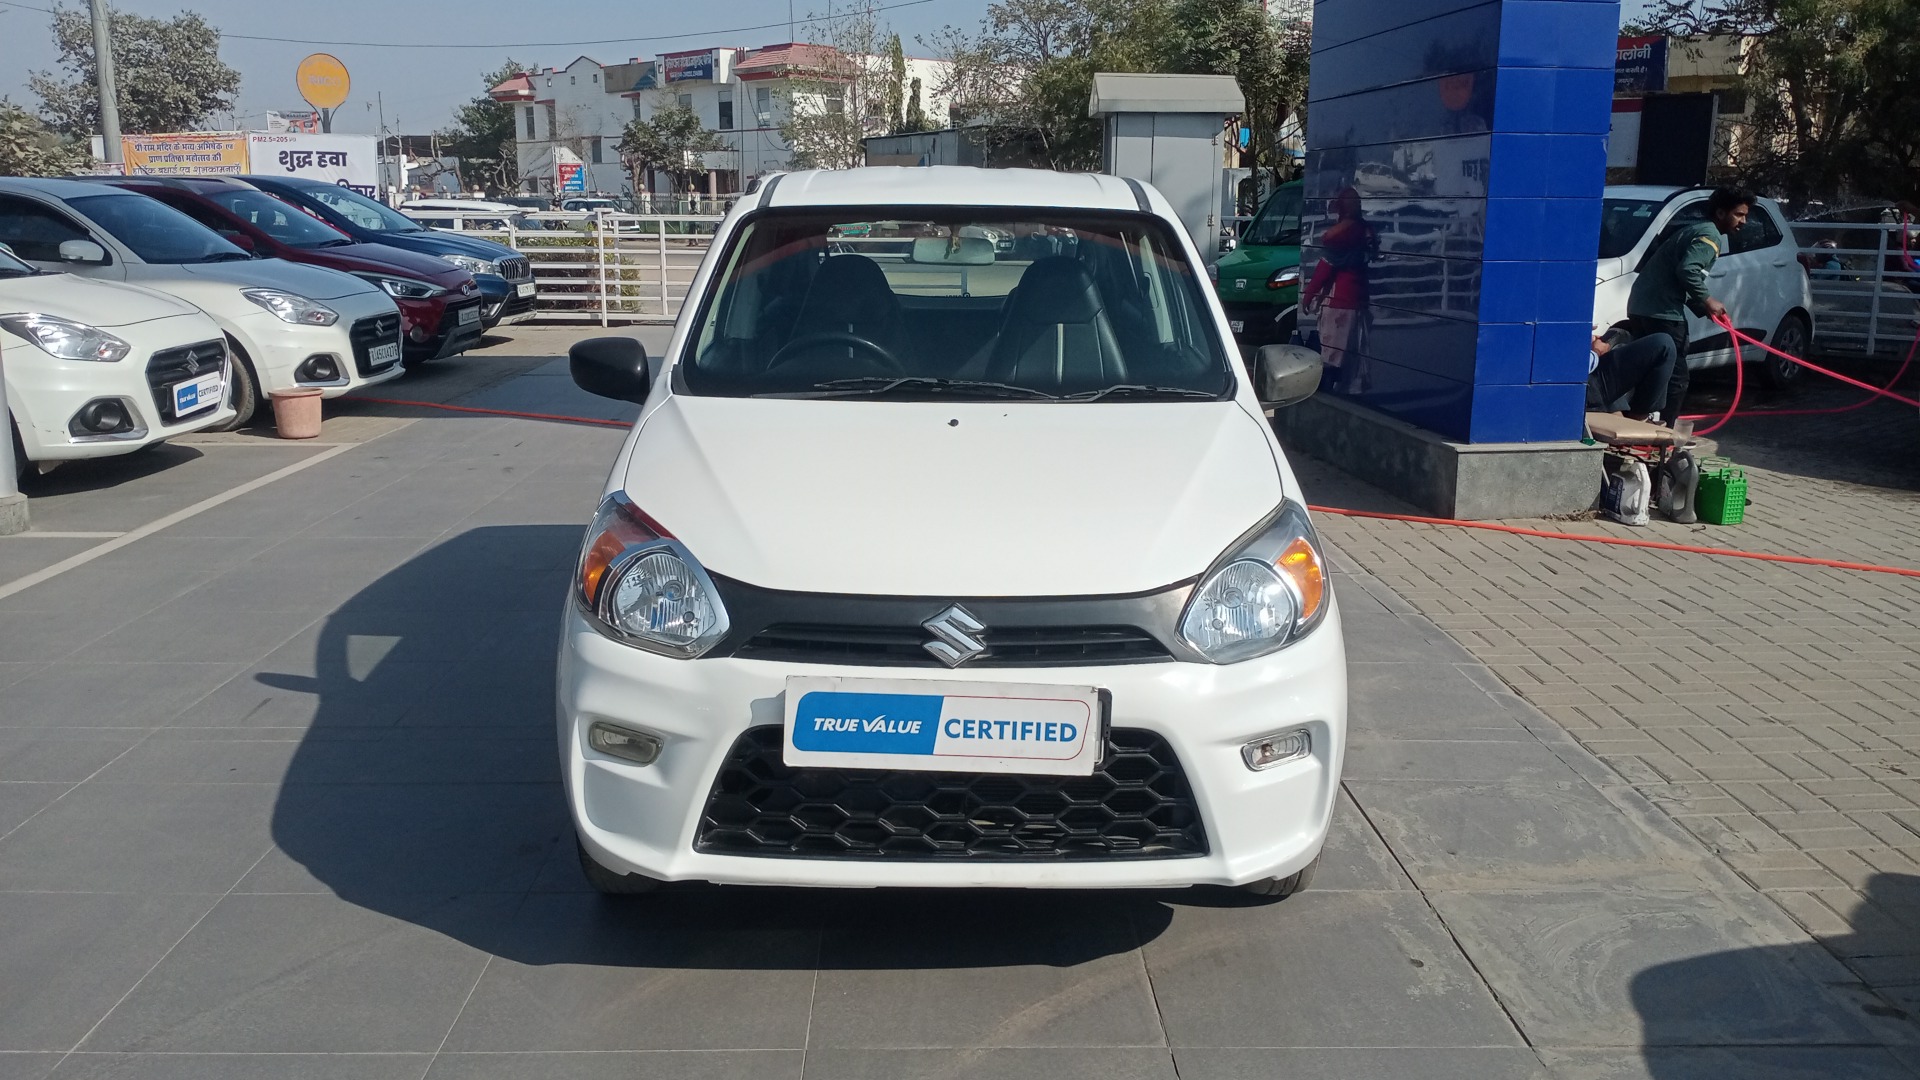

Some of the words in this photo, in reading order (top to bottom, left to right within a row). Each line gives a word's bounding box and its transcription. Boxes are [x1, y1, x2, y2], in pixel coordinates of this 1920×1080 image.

[144, 144, 155, 152] राम
[173, 140, 181, 151] के
[212, 151, 222, 162] की
[278, 150, 314, 172] शुद्ध
[316, 150, 348, 168] हवा
[813, 716, 858, 732] TRUE
[862, 714, 922, 735] VALUE
[944, 718, 1077, 743] CERTIFIED
